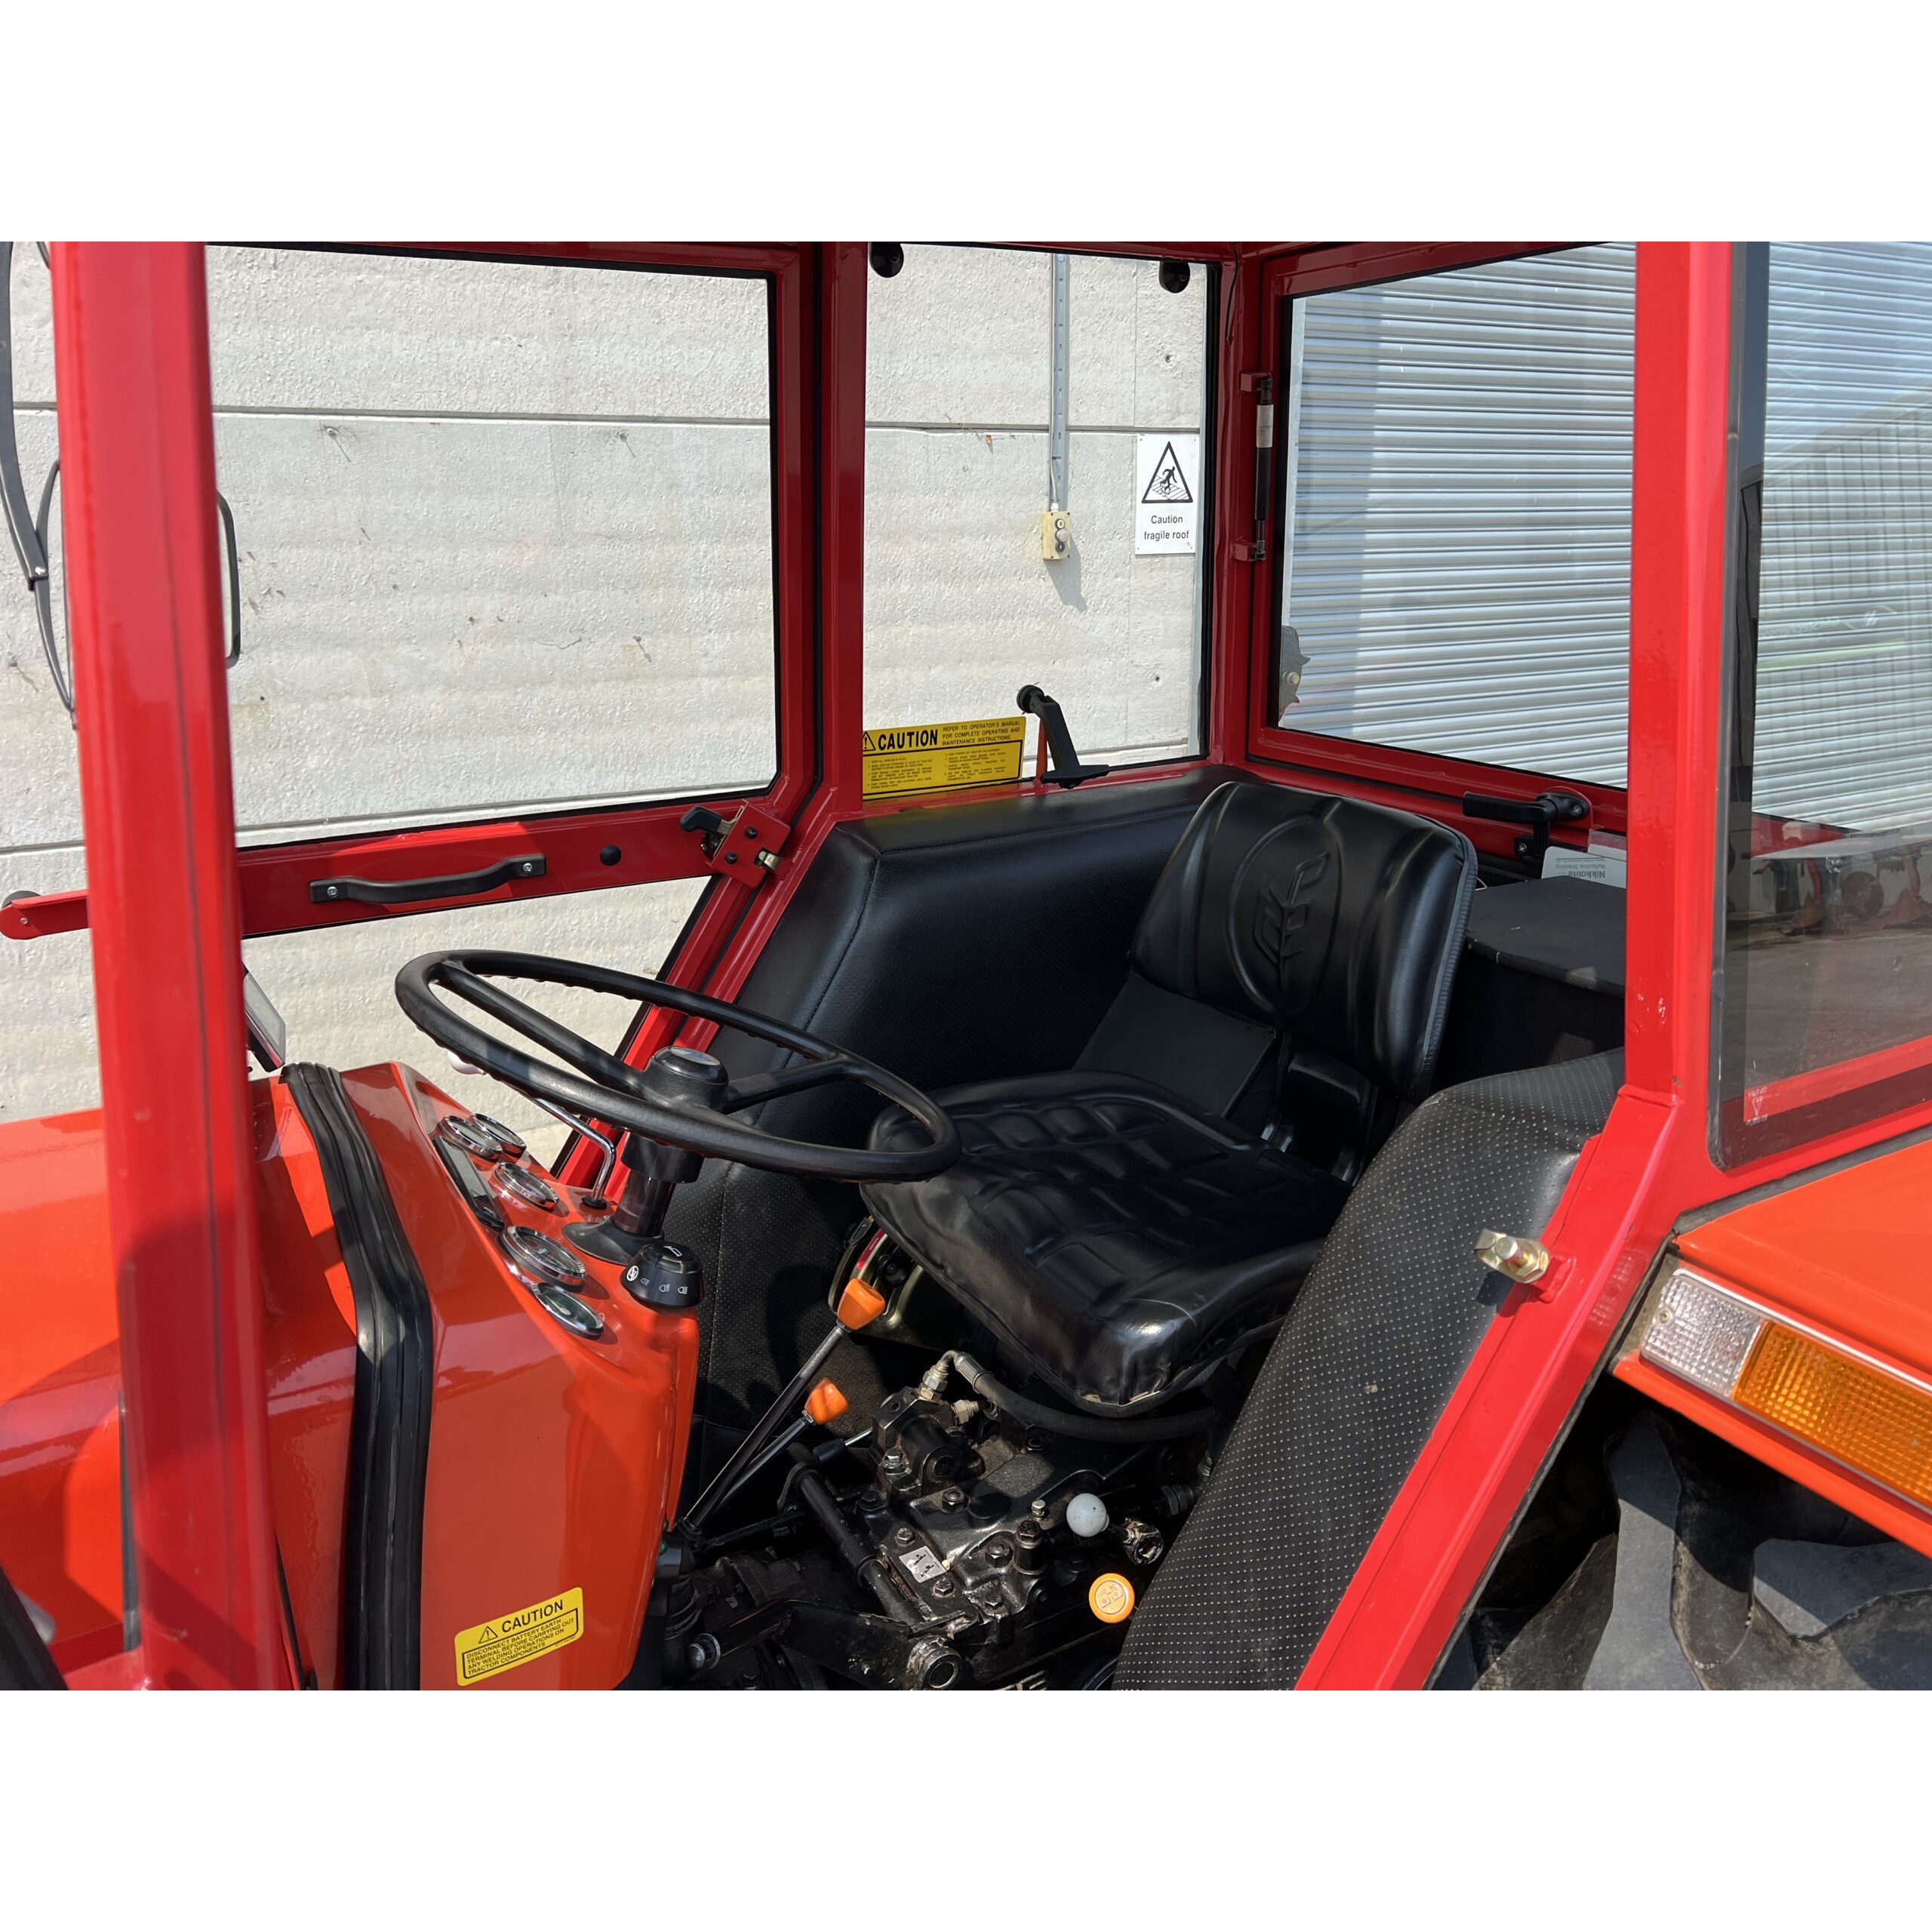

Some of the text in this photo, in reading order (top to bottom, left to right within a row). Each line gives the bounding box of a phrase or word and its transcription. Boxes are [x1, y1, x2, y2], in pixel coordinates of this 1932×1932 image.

[1144, 530, 1189, 541] fragile roof
[1151, 515, 1183, 524] Caution
[878, 730, 938, 750] CAUTION
[502, 1599, 563, 1633] CAUTION
[467, 1639, 510, 1659] DISCONNECT
[512, 1626, 540, 1643] BATTERY
[540, 1619, 561, 1630] EARTH
[467, 1649, 500, 1664] TERMINAL
[502, 1638, 528, 1651] BEFORE
[529, 1626, 561, 1641] CARRYING
[562, 1618, 574, 1627] OUT
[467, 1662, 481, 1670] ANY
[482, 1651, 512, 1664] WELDING
[514, 1632, 554, 1652] OPERATIONS
[467, 1642, 546, 1675] TRACTOR COMPONENTS
